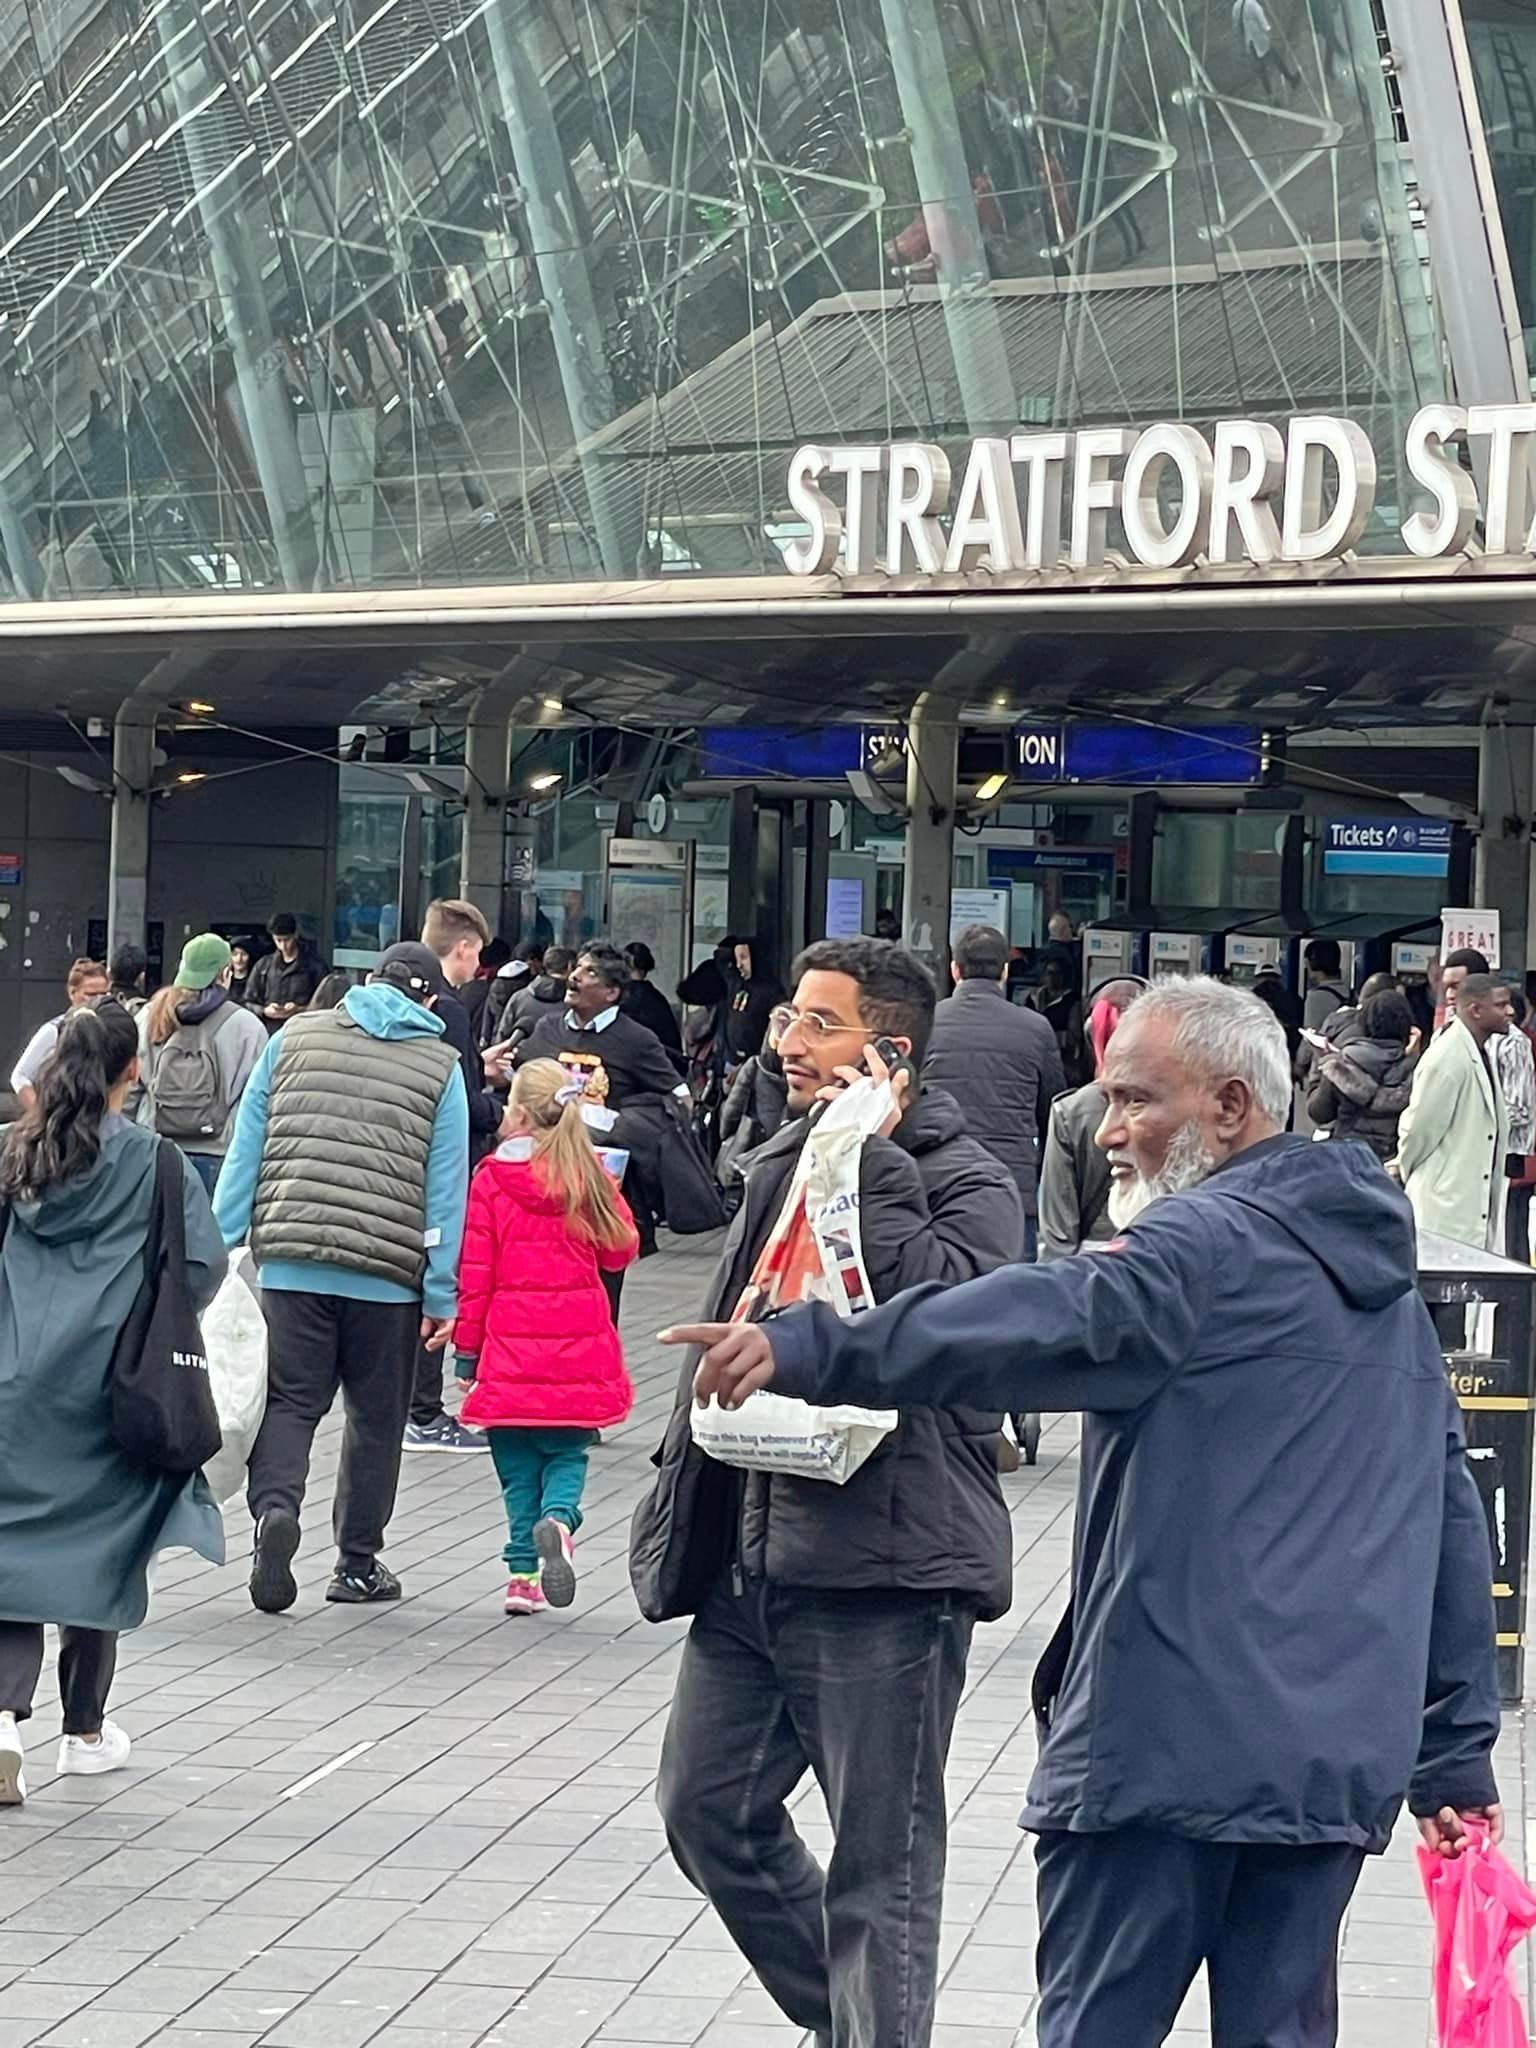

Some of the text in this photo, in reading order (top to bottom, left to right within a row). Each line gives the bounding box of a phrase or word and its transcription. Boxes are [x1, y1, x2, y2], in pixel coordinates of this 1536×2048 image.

[782, 403, 1536, 576] STRATFORD ST
[1016, 735, 1056, 764] ION
[1331, 824, 1383, 846] Tickets
[1447, 930, 1495, 950] GREAT
[1450, 1371, 1485, 1394] ter
